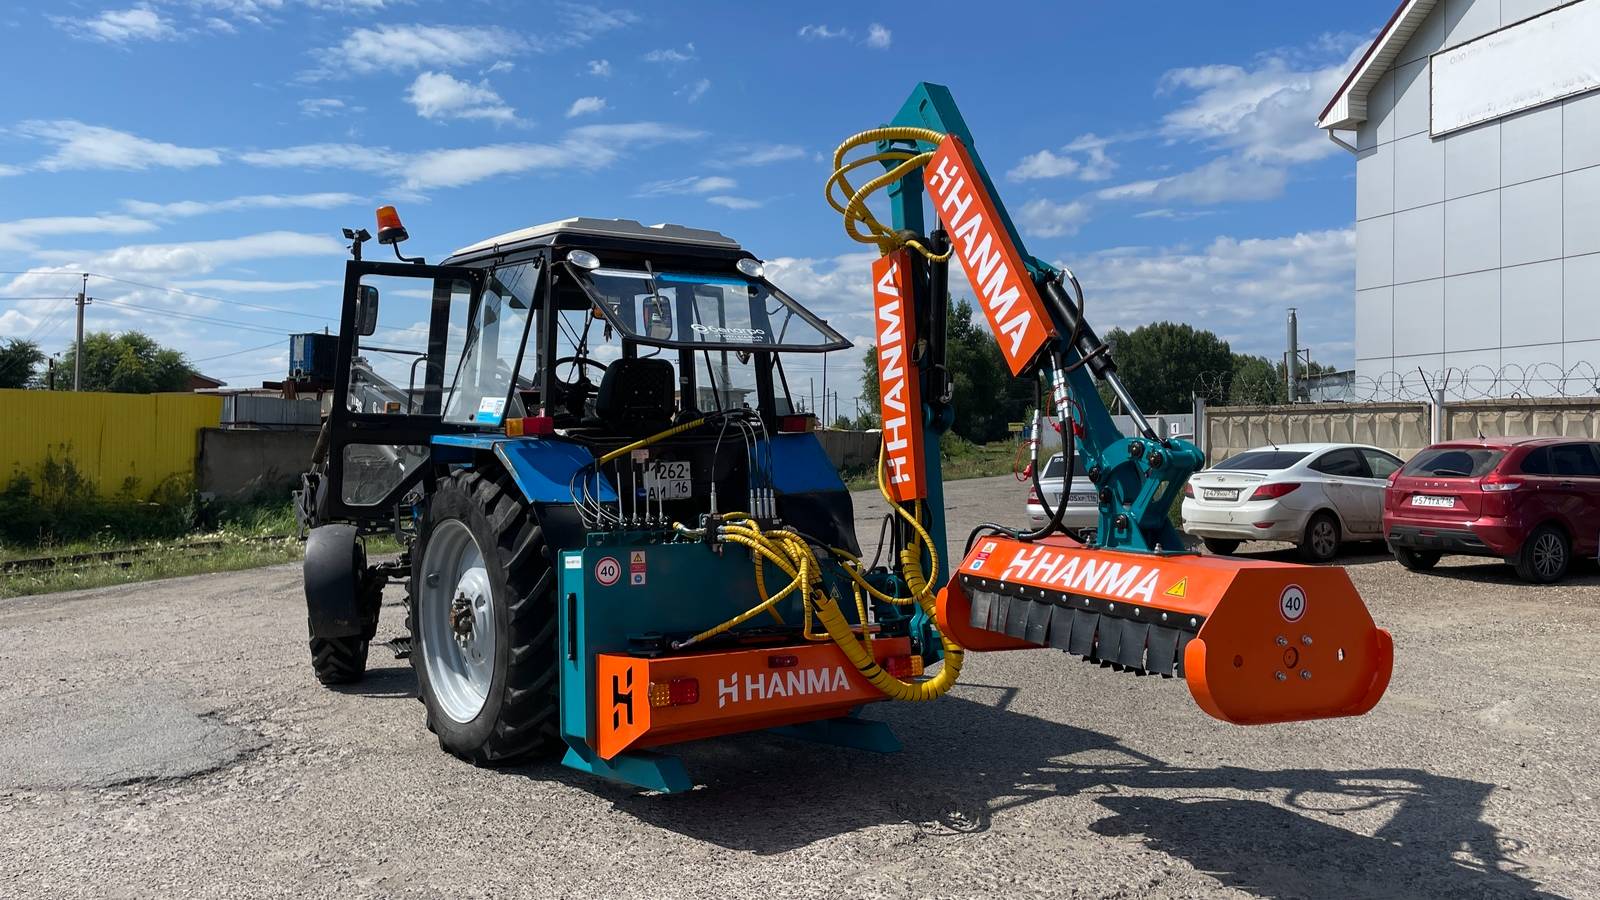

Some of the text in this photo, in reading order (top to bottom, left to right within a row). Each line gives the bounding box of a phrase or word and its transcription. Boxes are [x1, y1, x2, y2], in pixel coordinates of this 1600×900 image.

[942, 176, 1032, 358] HANMA
[877, 262, 908, 451] HANMA
[650, 463, 685, 479] 1262
[675, 481, 688, 493] 16
[600, 565, 615, 577] 40
[1028, 552, 1160, 603] HANMA
[1285, 597, 1301, 611] 40
[745, 666, 851, 701] HANMA
